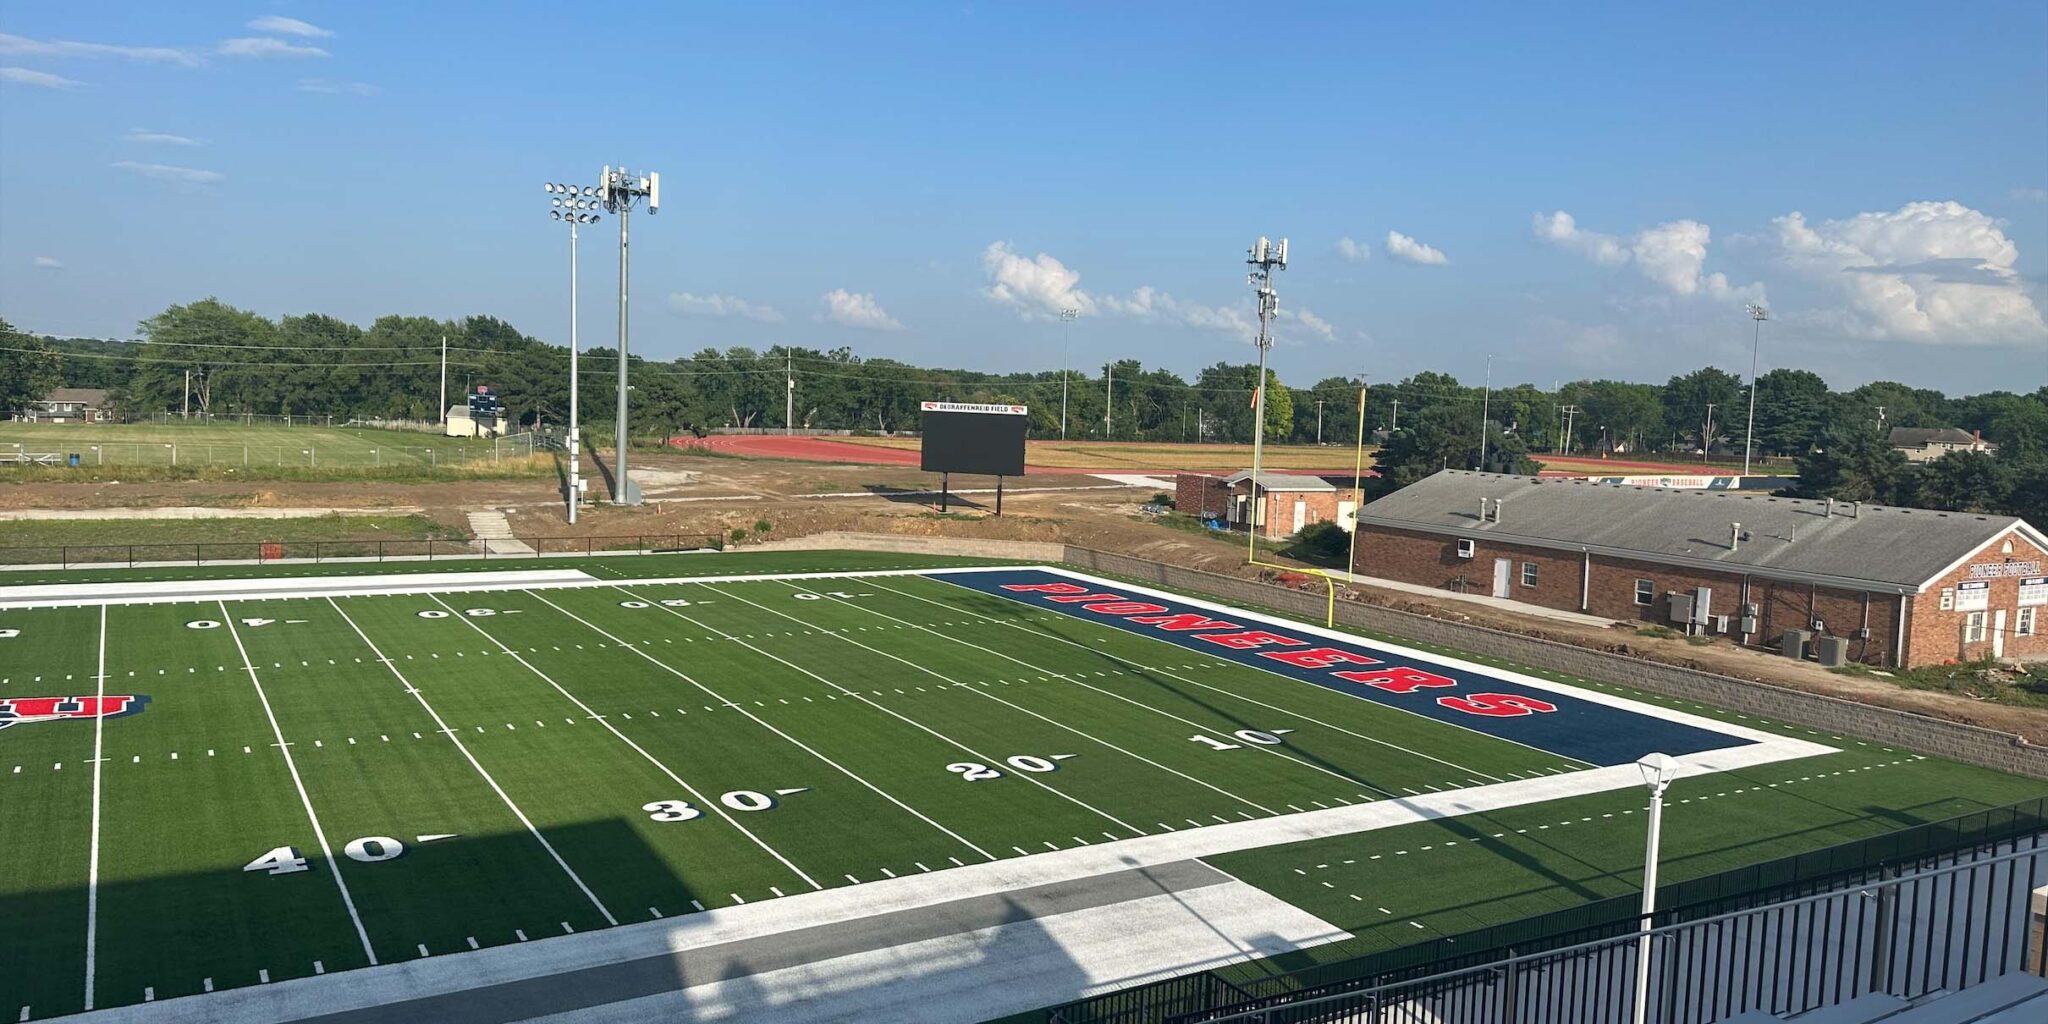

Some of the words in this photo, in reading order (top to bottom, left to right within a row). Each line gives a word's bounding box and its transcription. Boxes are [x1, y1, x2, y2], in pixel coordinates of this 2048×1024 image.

[1631, 478, 1659, 486] PIONEER
[1672, 479, 1704, 487] BASEBALL
[1969, 563, 2003, 578] PIONEER
[2003, 561, 2041, 576] FOOTBALL
[999, 582, 1558, 718] PIONEERS
